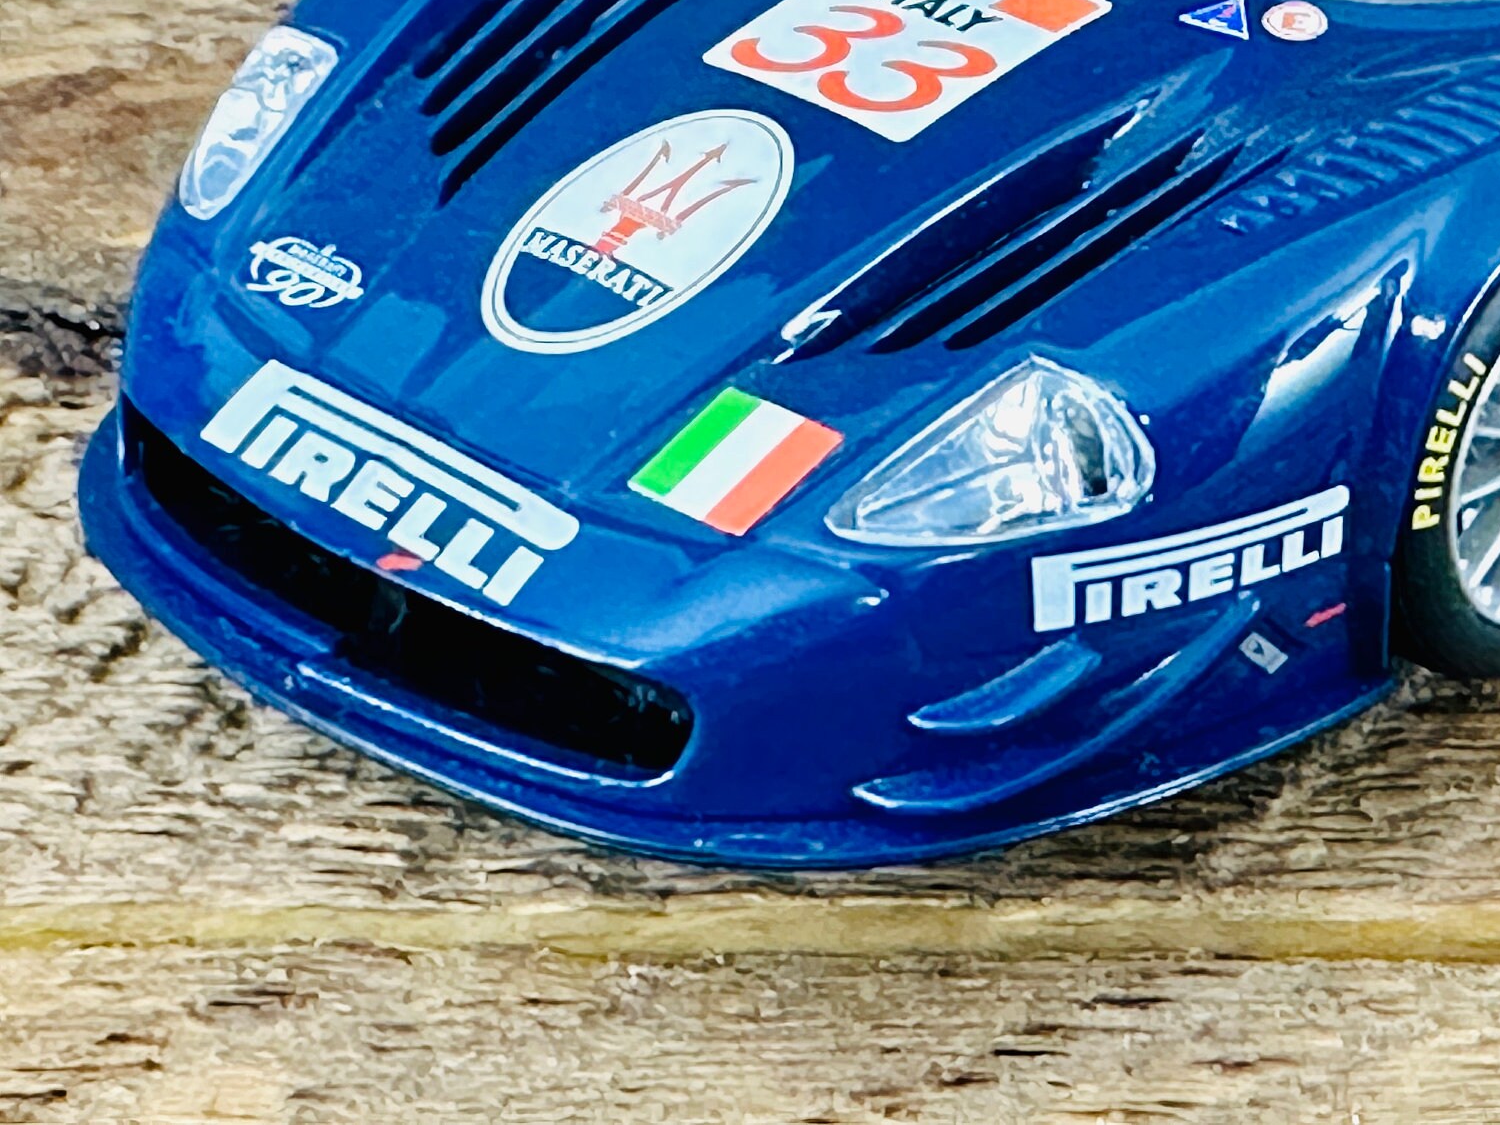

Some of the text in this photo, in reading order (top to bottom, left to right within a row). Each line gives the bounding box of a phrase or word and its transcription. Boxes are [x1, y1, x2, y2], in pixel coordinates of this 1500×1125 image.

[731, 6, 998, 112] 33
[522, 231, 665, 307] MASERATI
[200, 360, 580, 606] PIRELLI
[1412, 352, 1487, 530] PIRELLI
[1031, 485, 1350, 632] PIRELLI
